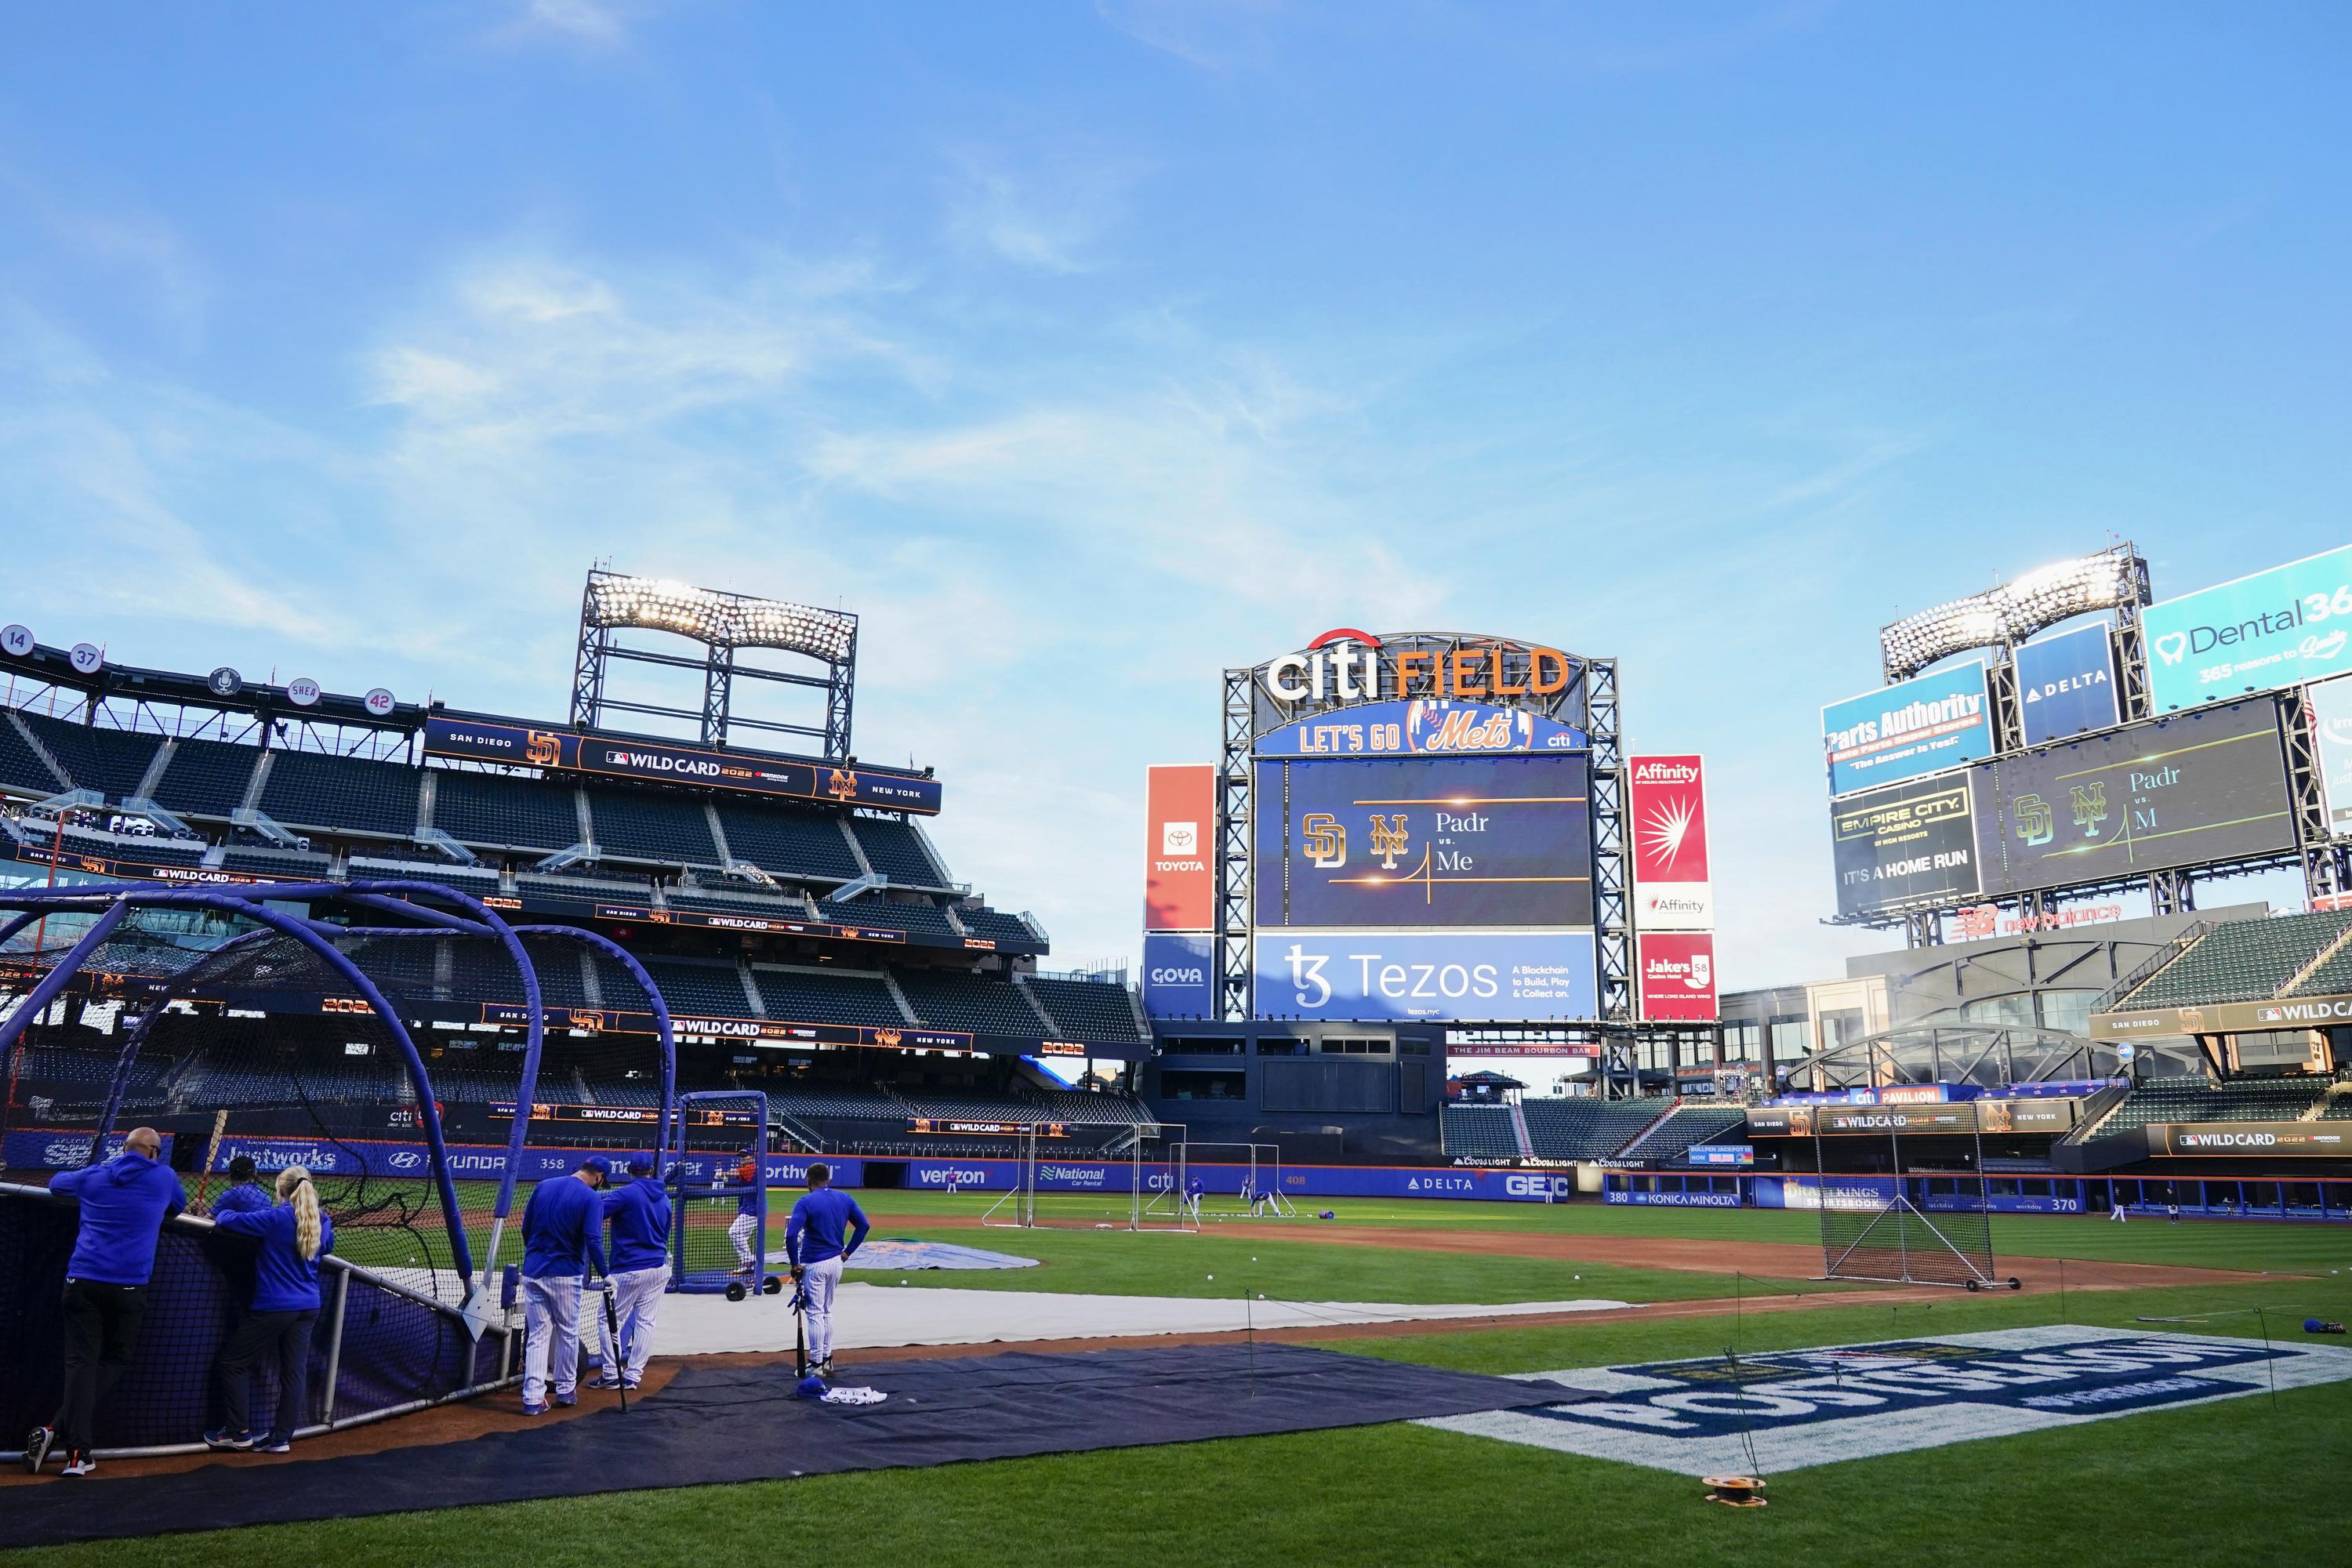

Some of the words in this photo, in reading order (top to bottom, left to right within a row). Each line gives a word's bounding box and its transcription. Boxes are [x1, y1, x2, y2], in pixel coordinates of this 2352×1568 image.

[9, 632, 25, 648] 14
[76, 650, 96, 666] 37
[1268, 638, 1378, 701] citi
[1397, 648, 1569, 697] FIELD
[2200, 663, 2233, 684] 365
[2234, 654, 2281, 672] reasons
[2283, 649, 2298, 659] to
[2045, 670, 2107, 697] DELTA
[293, 685, 316, 697] SHEA
[370, 695, 390, 709] 42
[1826, 720, 1878, 753] Parts
[1882, 694, 1980, 739] Authority
[1300, 724, 1363, 753] LET'S
[1370, 724, 1399, 750] GO
[1427, 710, 1512, 750] Mets
[450, 733, 473, 743] SAN
[477, 736, 512, 747] DIEGO
[1548, 733, 1570, 747] citi
[1832, 749, 1858, 761] Auto
[1860, 740, 1894, 753] Parts
[1895, 731, 1933, 744] Super
[1933, 717, 1978, 734] Stores
[1875, 747, 1917, 764] Answer
[630, 753, 673, 771] WILD
[674, 759, 721, 776] CARD
[721, 768, 753, 778] 2022
[1635, 764, 1699, 782] Affinity
[2129, 766, 2180, 792] Padr
[872, 786, 893, 795] NEW
[897, 789, 921, 798] YORK
[1436, 812, 1489, 832] Padr
[1842, 808, 1911, 832] EMPIRE
[1878, 818, 1922, 834] CASINO
[2134, 808, 2158, 830] M
[1882, 837, 1897, 845] MGM
[1898, 830, 1929, 842] RESORTS
[1156, 862, 1205, 872] TOYOTA
[1436, 851, 1473, 871] Me
[1844, 868, 1870, 885] IT'S
[1873, 866, 1883, 880] A
[1886, 856, 1931, 877] HOME
[1934, 849, 1968, 869] RUN
[169, 871, 198, 880] WILD
[198, 872, 230, 883] CARD
[483, 897, 522, 909] 2022
[1659, 899, 1704, 913] Affinity
[721, 918, 743, 927] WILD
[743, 920, 768, 930] CARD
[2004, 916, 2039, 933] new
[2042, 905, 2122, 927] balance
[964, 938, 996, 950] 2022
[1512, 966, 1519, 975] A
[1521, 965, 1569, 975] Blockchain
[1646, 958, 1690, 973] Jake's
[1694, 964, 1708, 972] 58
[1152, 967, 1203, 983] GOYA
[1349, 954, 1498, 998] Tezos
[1524, 978, 1549, 988] Build,
[1551, 977, 1570, 988] Play
[1513, 989, 1521, 998] &
[1523, 989, 1553, 998] Collect
[1555, 989, 1570, 998] on.
[1407, 1007, 1439, 1017] tezos.nyc
[2281, 1004, 2332, 1020] WILD
[686, 1020, 722, 1033] WILD
[722, 1022, 760, 1036] CARD
[1041, 1041, 1085, 1055] 2022
[1856, 1091, 1875, 1104] citi
[1882, 1090, 1935, 1104] PAVILION
[390, 1107, 412, 1122] citi
[594, 1110, 616, 1119] WILD
[616, 1111, 641, 1120] CARD
[1849, 1116, 1875, 1127] WILD
[1875, 1116, 1907, 1127] CARD
[2198, 1134, 2234, 1146] WILD
[2235, 1134, 2275, 1145] CARD
[540, 1158, 564, 1169] 358
[1464, 1156, 1488, 1166] Coors
[1488, 1158, 1511, 1167] LIGHT
[1529, 1156, 1554, 1167] Coors
[1599, 1156, 1621, 1167] Coors
[1622, 1160, 1645, 1168] LIGHT
[1149, 1171, 1174, 1189] citi
[1286, 1176, 1305, 1185] 408
[1424, 1178, 1473, 1190] DELTA
[1610, 1192, 1628, 1203] 380
[1649, 1194, 1686, 1205] KONICA
[1690, 1195, 1736, 1206] MINOLTA
[2052, 1200, 2077, 1211] 370
[1546, 1340, 2268, 1429] POSTSEASON
